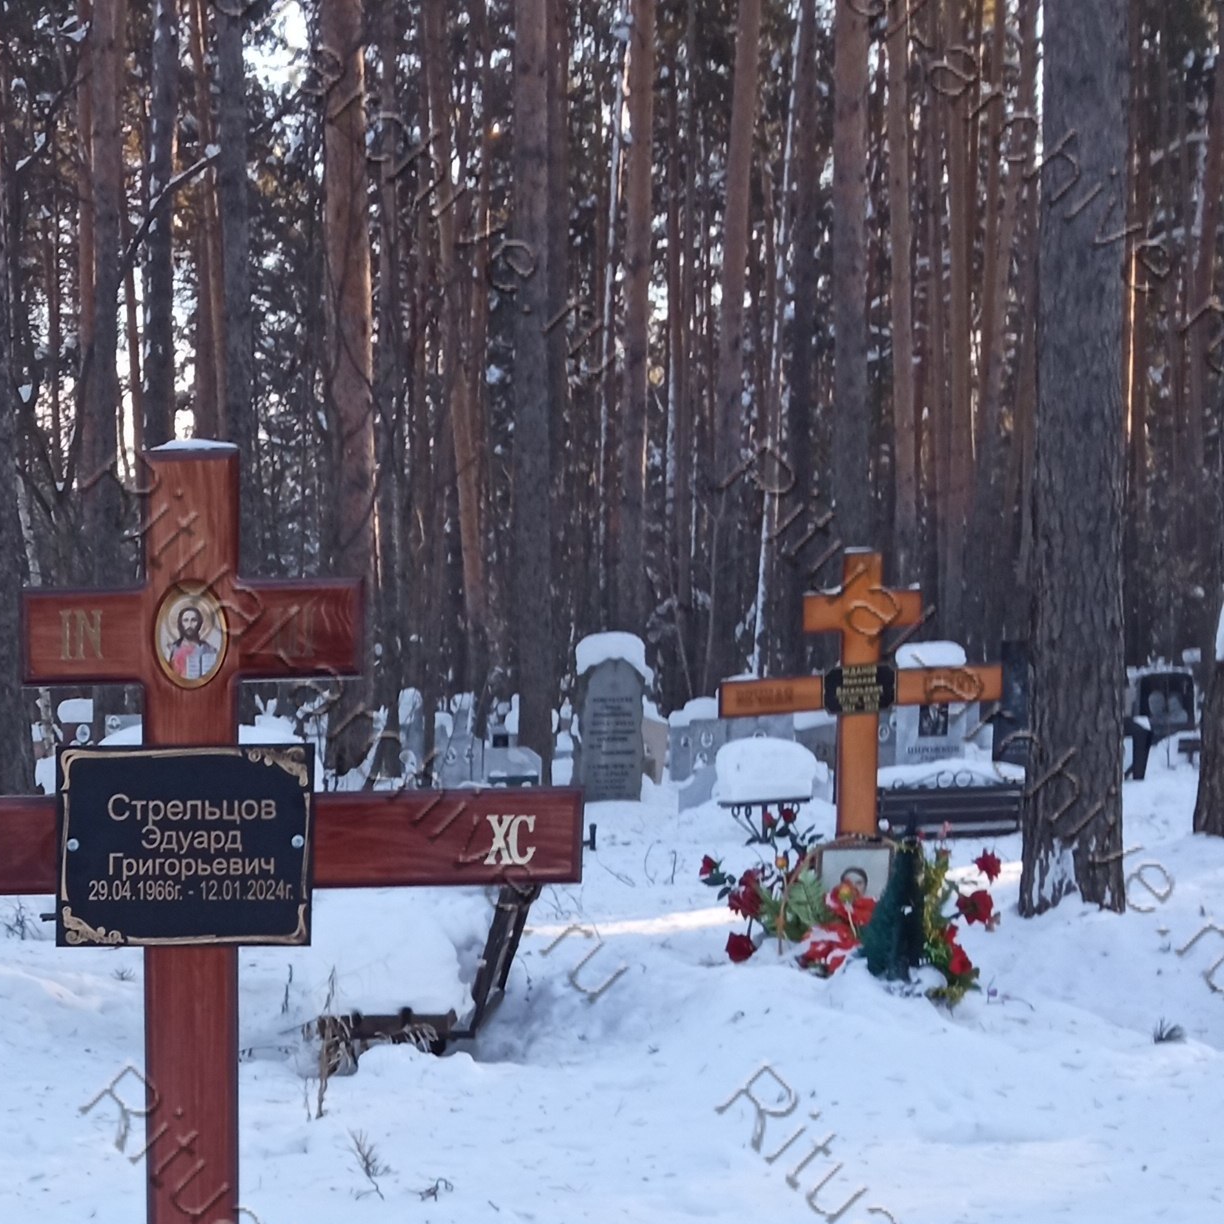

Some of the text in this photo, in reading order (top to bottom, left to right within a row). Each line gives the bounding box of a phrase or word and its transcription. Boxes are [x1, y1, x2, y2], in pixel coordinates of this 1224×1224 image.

[107, 793, 277, 826] Стрельцов
[141, 825, 243, 854] Эдуард
[108, 853, 275, 880] Григорьевич
[88, 879, 183, 901] 29.04.1966г.
[200, 879, 294, 901] 12.01.2024г.
